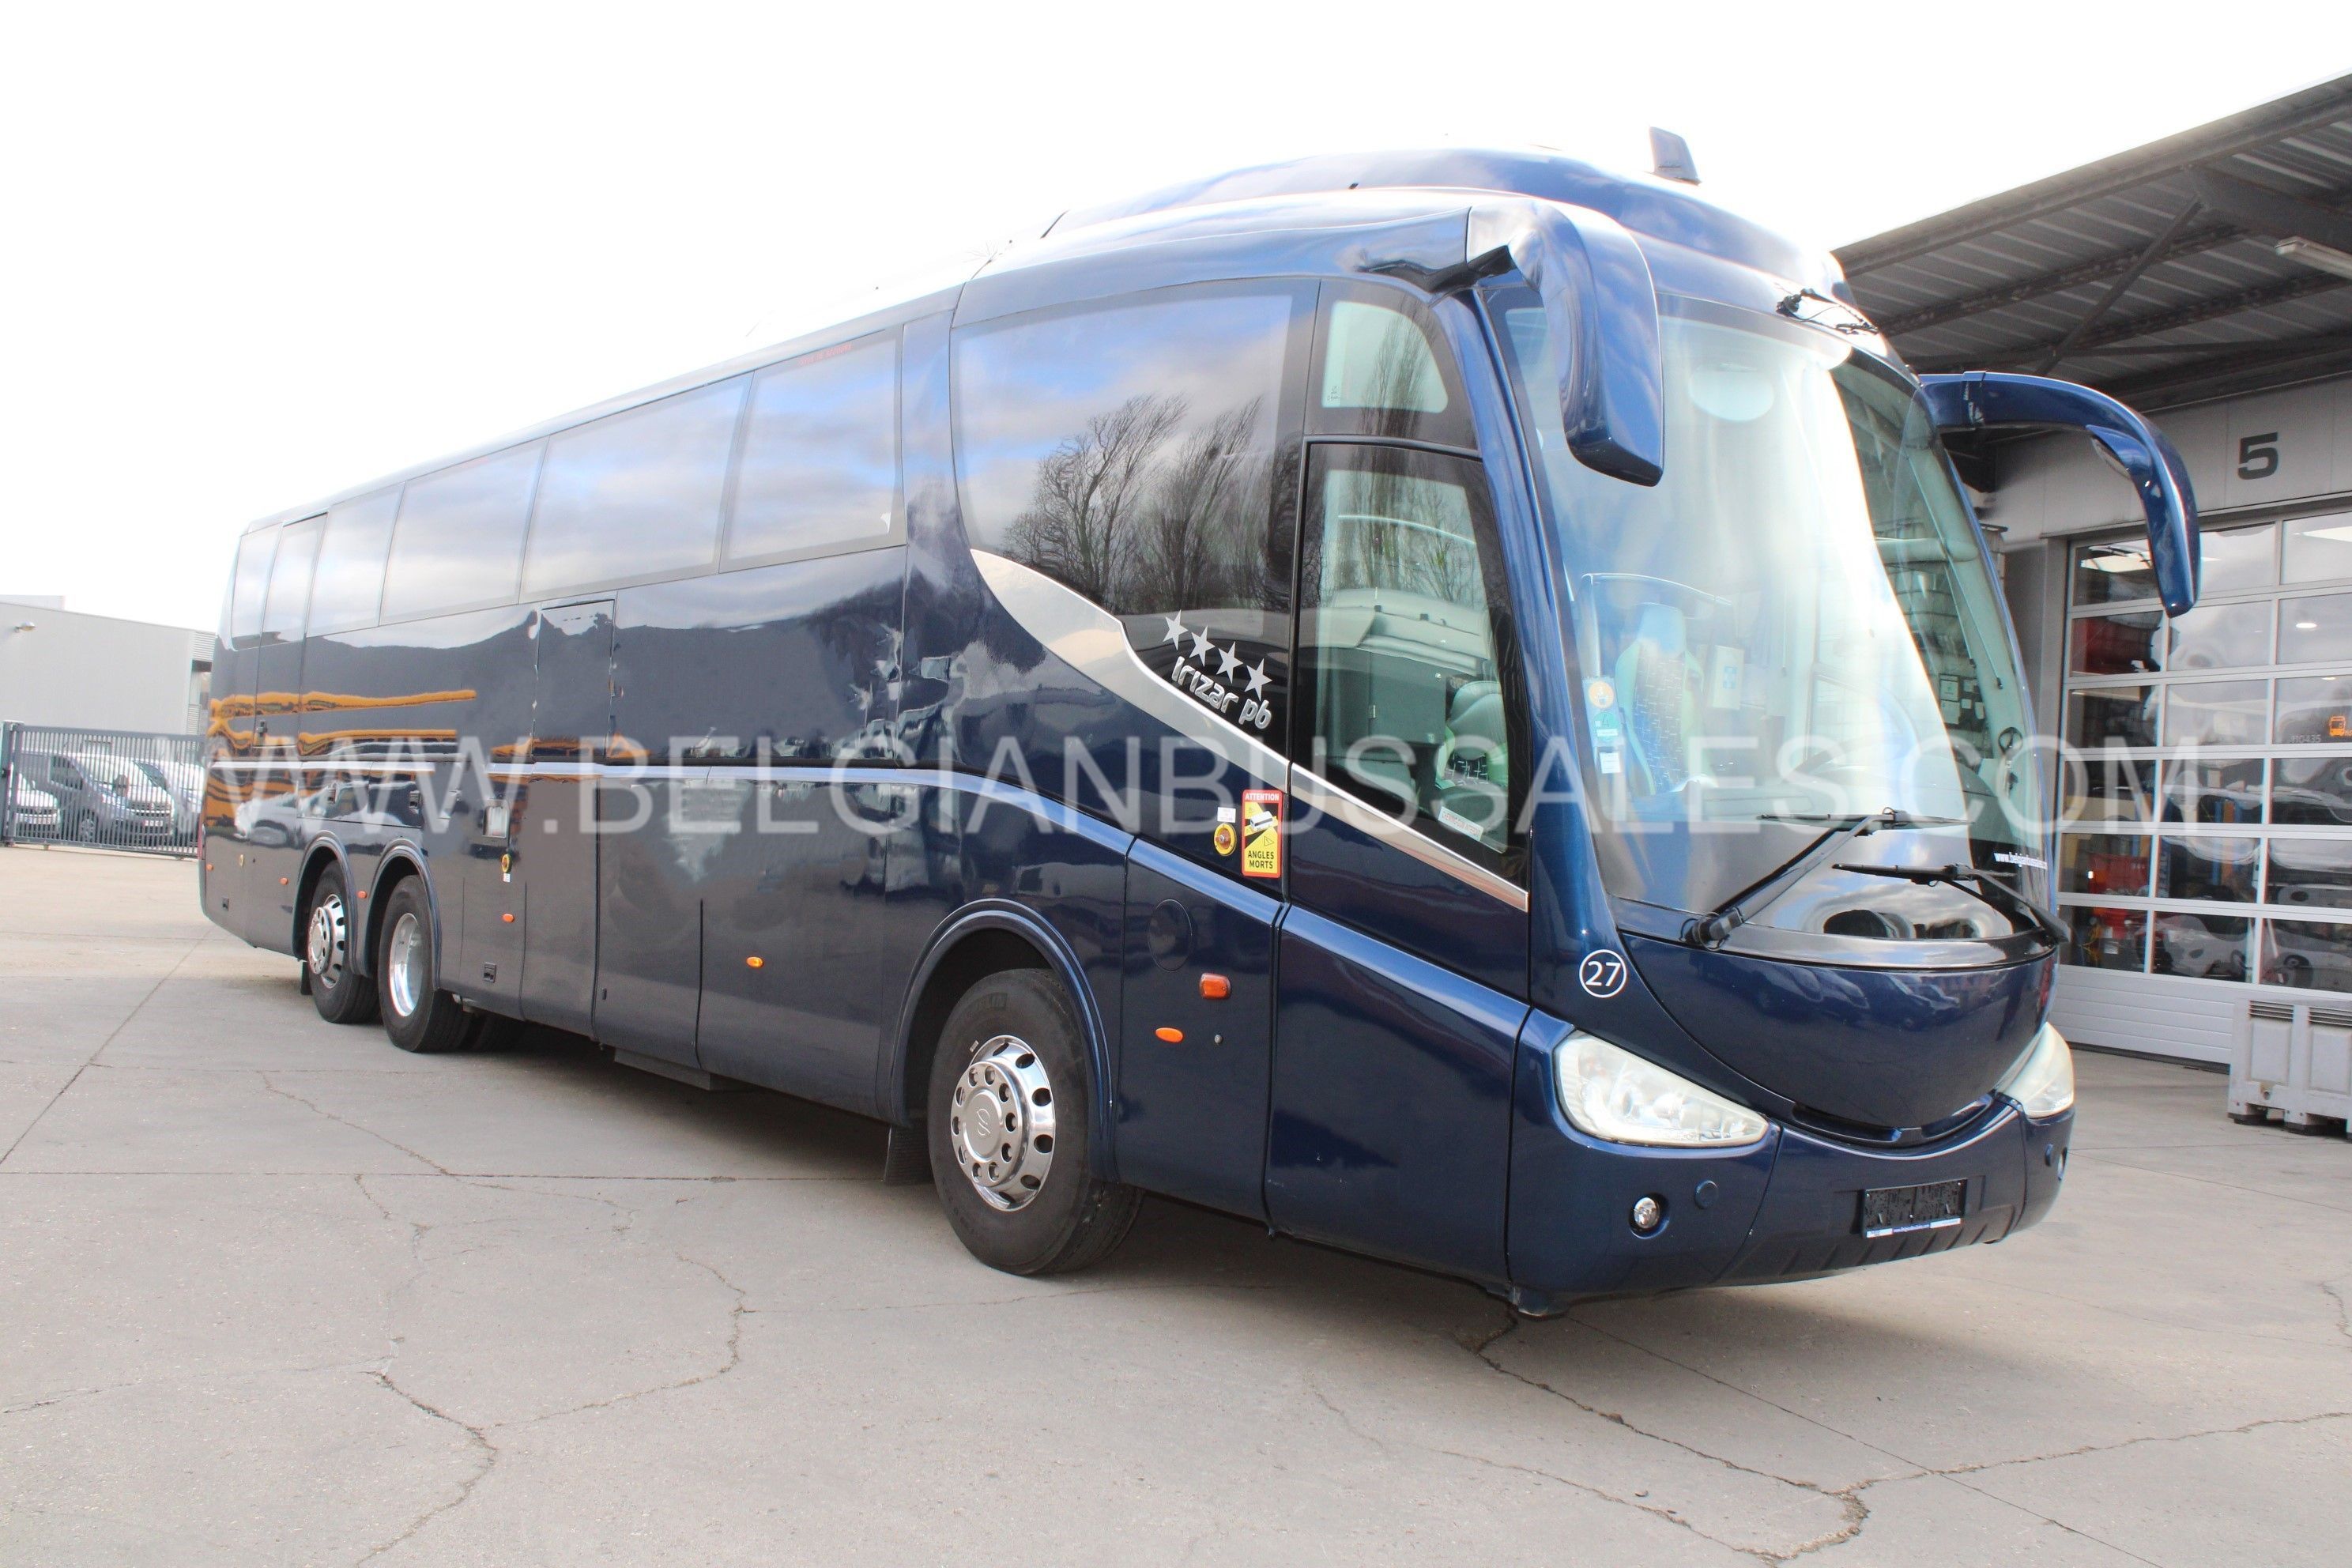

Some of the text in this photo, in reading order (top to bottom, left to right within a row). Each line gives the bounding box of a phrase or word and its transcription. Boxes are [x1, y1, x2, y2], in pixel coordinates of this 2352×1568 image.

[2237, 432, 2278, 480] 5
[1245, 793, 1280, 801] ATTENTION
[1247, 850, 1275, 859] ANGLES
[1249, 860, 1273, 869] MORTS
[1585, 960, 1622, 987] 27
